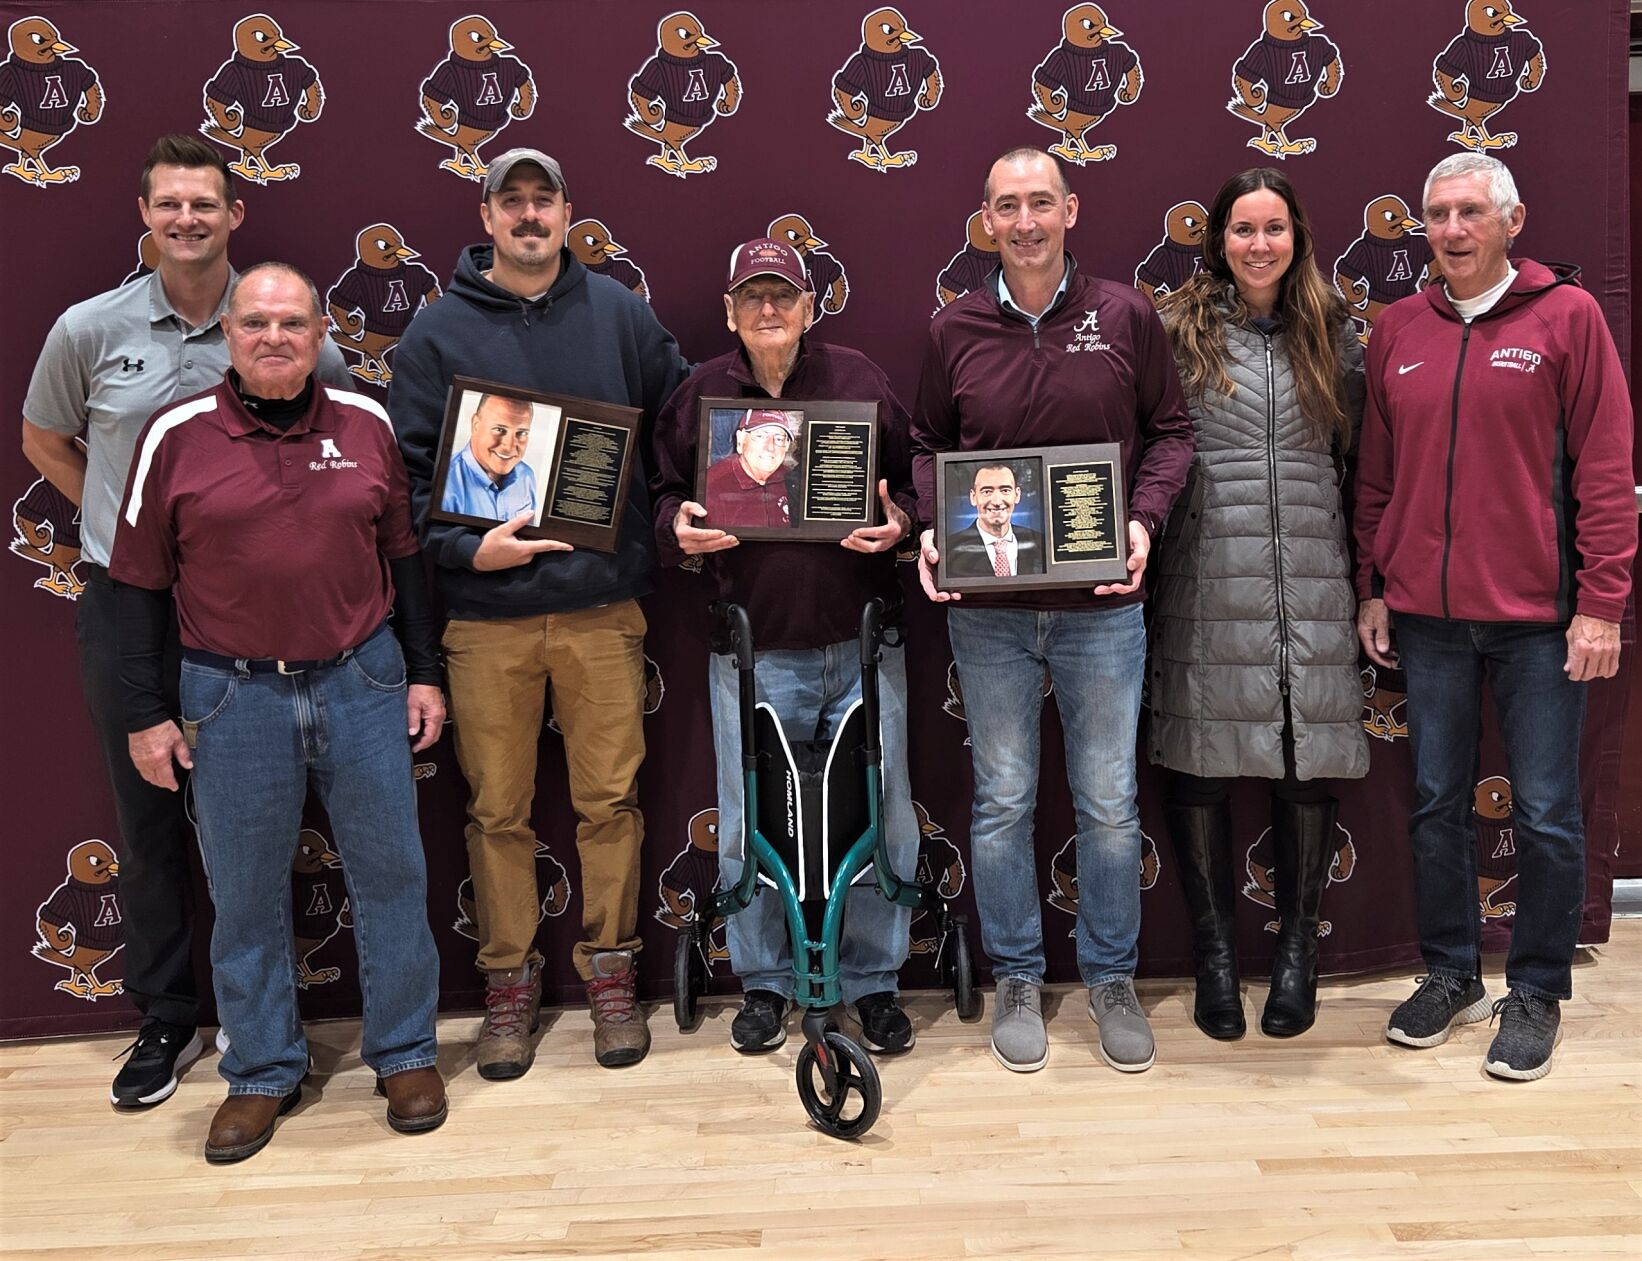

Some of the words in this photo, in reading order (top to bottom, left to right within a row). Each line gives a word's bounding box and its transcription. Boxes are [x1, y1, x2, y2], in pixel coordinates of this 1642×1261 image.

[1084, 58, 1111, 92] A
[1284, 50, 1312, 85] A
[1486, 45, 1514, 79] A
[40, 75, 69, 109] A
[261, 73, 290, 107] A
[475, 72, 504, 106] A
[682, 68, 709, 102] A
[885, 63, 911, 97] A
[748, 243, 788, 256] ANTIGO
[750, 257, 787, 265] FOOTBALL
[1386, 249, 1413, 282] A
[382, 279, 410, 312] A
[1073, 310, 1100, 332] A
[1066, 342, 1082, 353] Red
[1084, 341, 1111, 352] Robins
[1074, 333, 1101, 344] Antigo
[1490, 348, 1541, 365] ANTIGO
[309, 459, 328, 471] Red
[330, 458, 358, 470] Robins
[320, 438, 342, 458] A
[786, 770, 794, 837] HOMLAND
[1491, 828, 1516, 859] A
[94, 893, 122, 927] A
[305, 883, 333, 916] A
